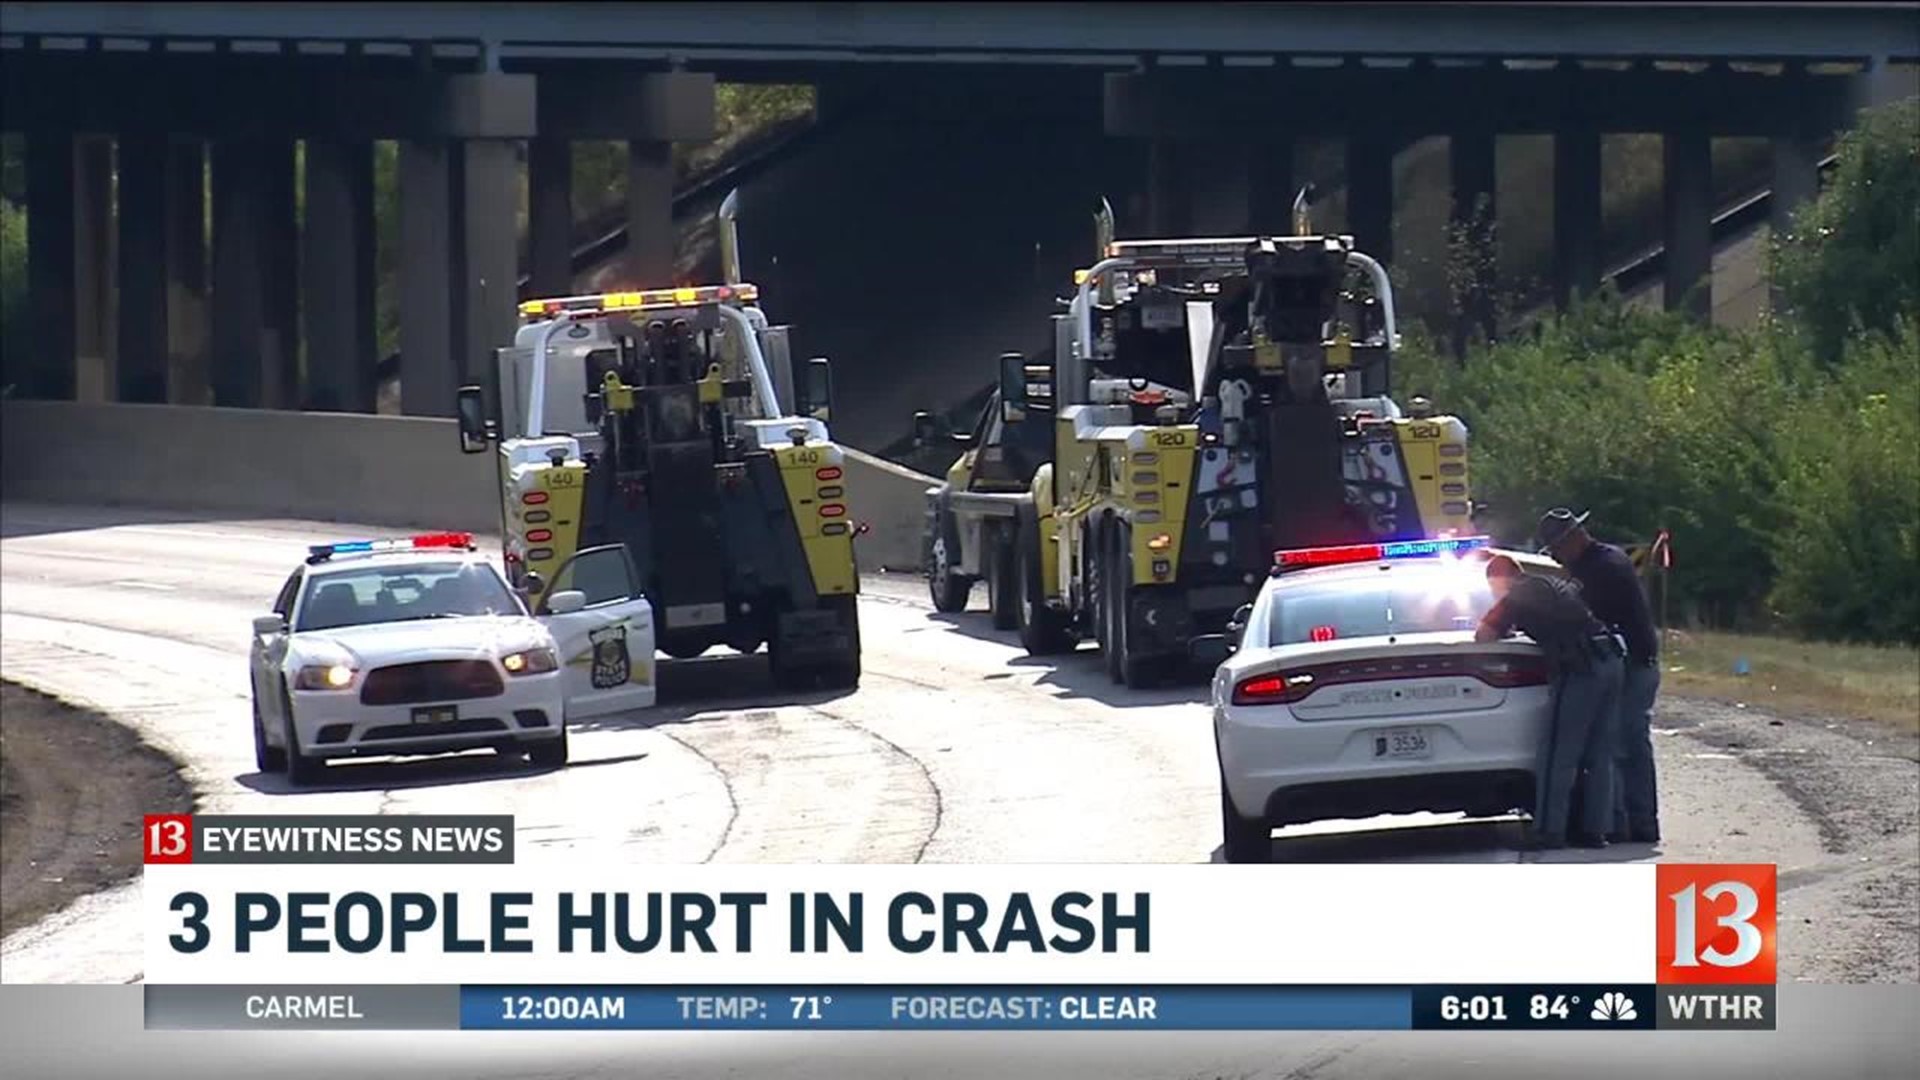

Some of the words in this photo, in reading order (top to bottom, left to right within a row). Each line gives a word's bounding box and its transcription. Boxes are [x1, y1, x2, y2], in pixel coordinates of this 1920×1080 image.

[1152, 432, 1185, 446] 120
[1408, 425, 1441, 439] 120
[788, 450, 818, 466] 140
[542, 471, 573, 487] 140
